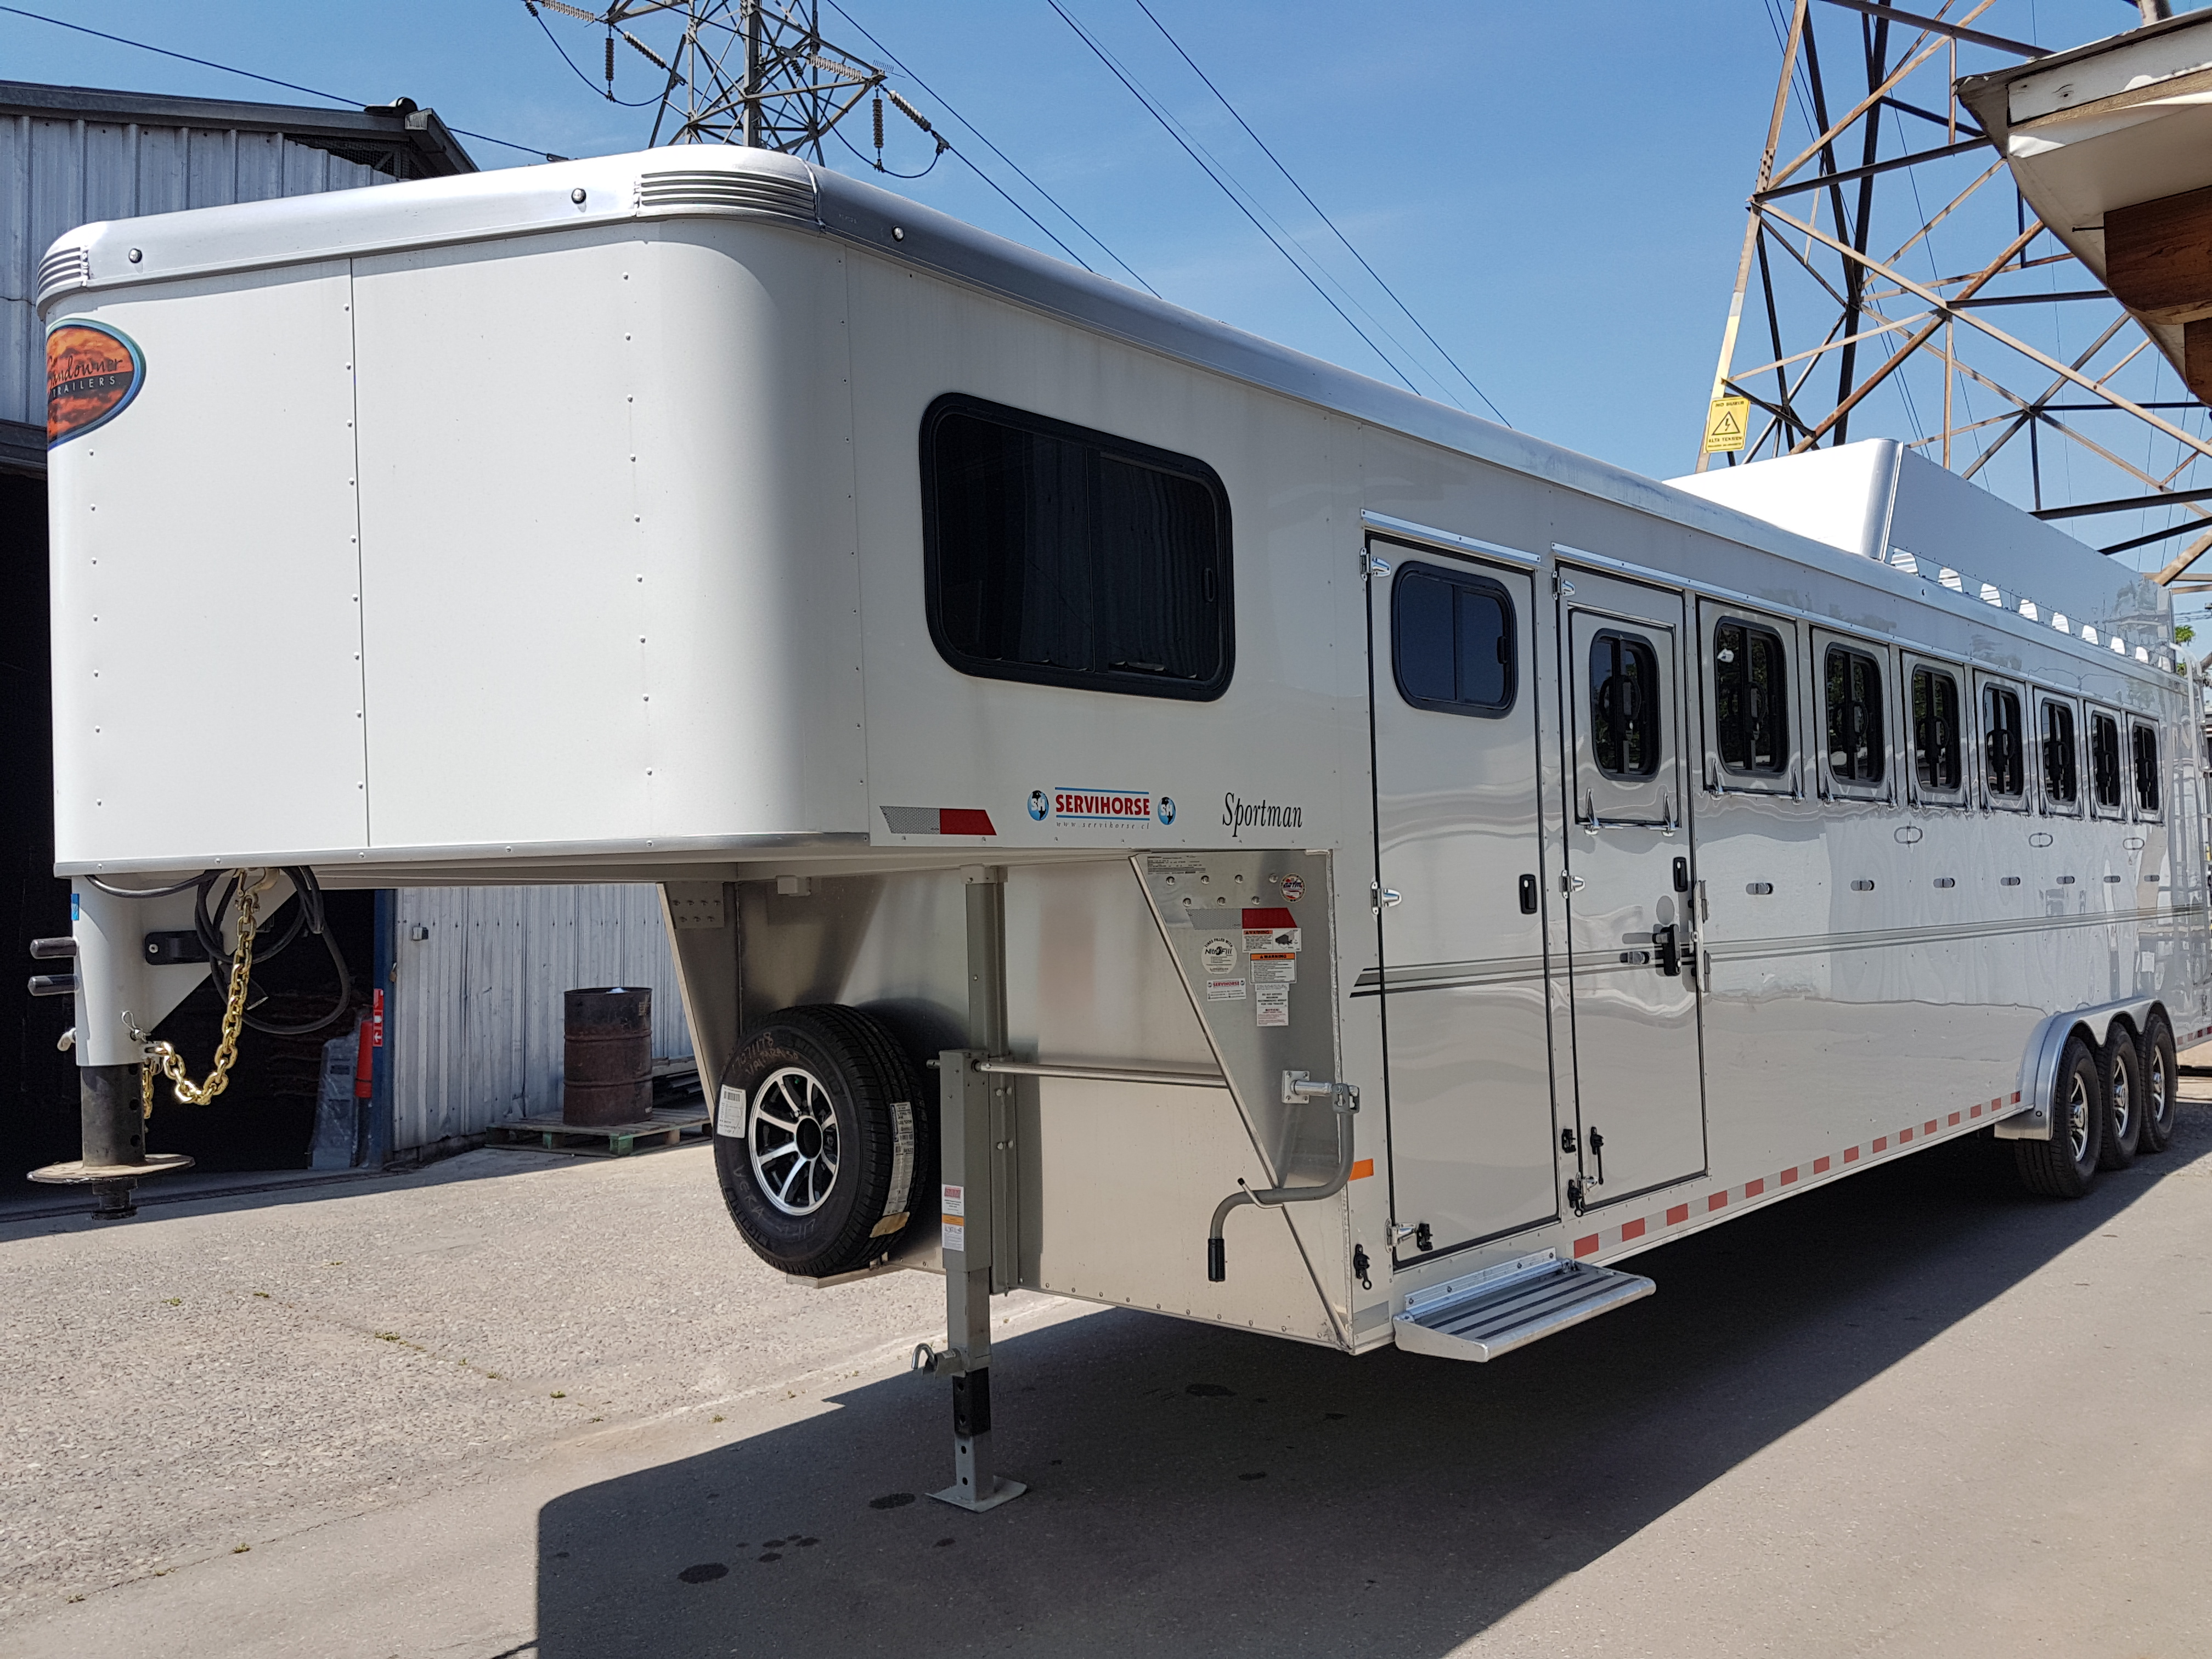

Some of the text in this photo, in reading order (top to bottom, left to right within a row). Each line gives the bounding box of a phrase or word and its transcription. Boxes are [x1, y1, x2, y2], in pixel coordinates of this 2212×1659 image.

[53, 375, 116, 398] TRAILERS
[1031, 797, 1045, 811] SH
[1056, 794, 1150, 815] SERVIHORSE
[1222, 792, 1302, 837] Sportman
